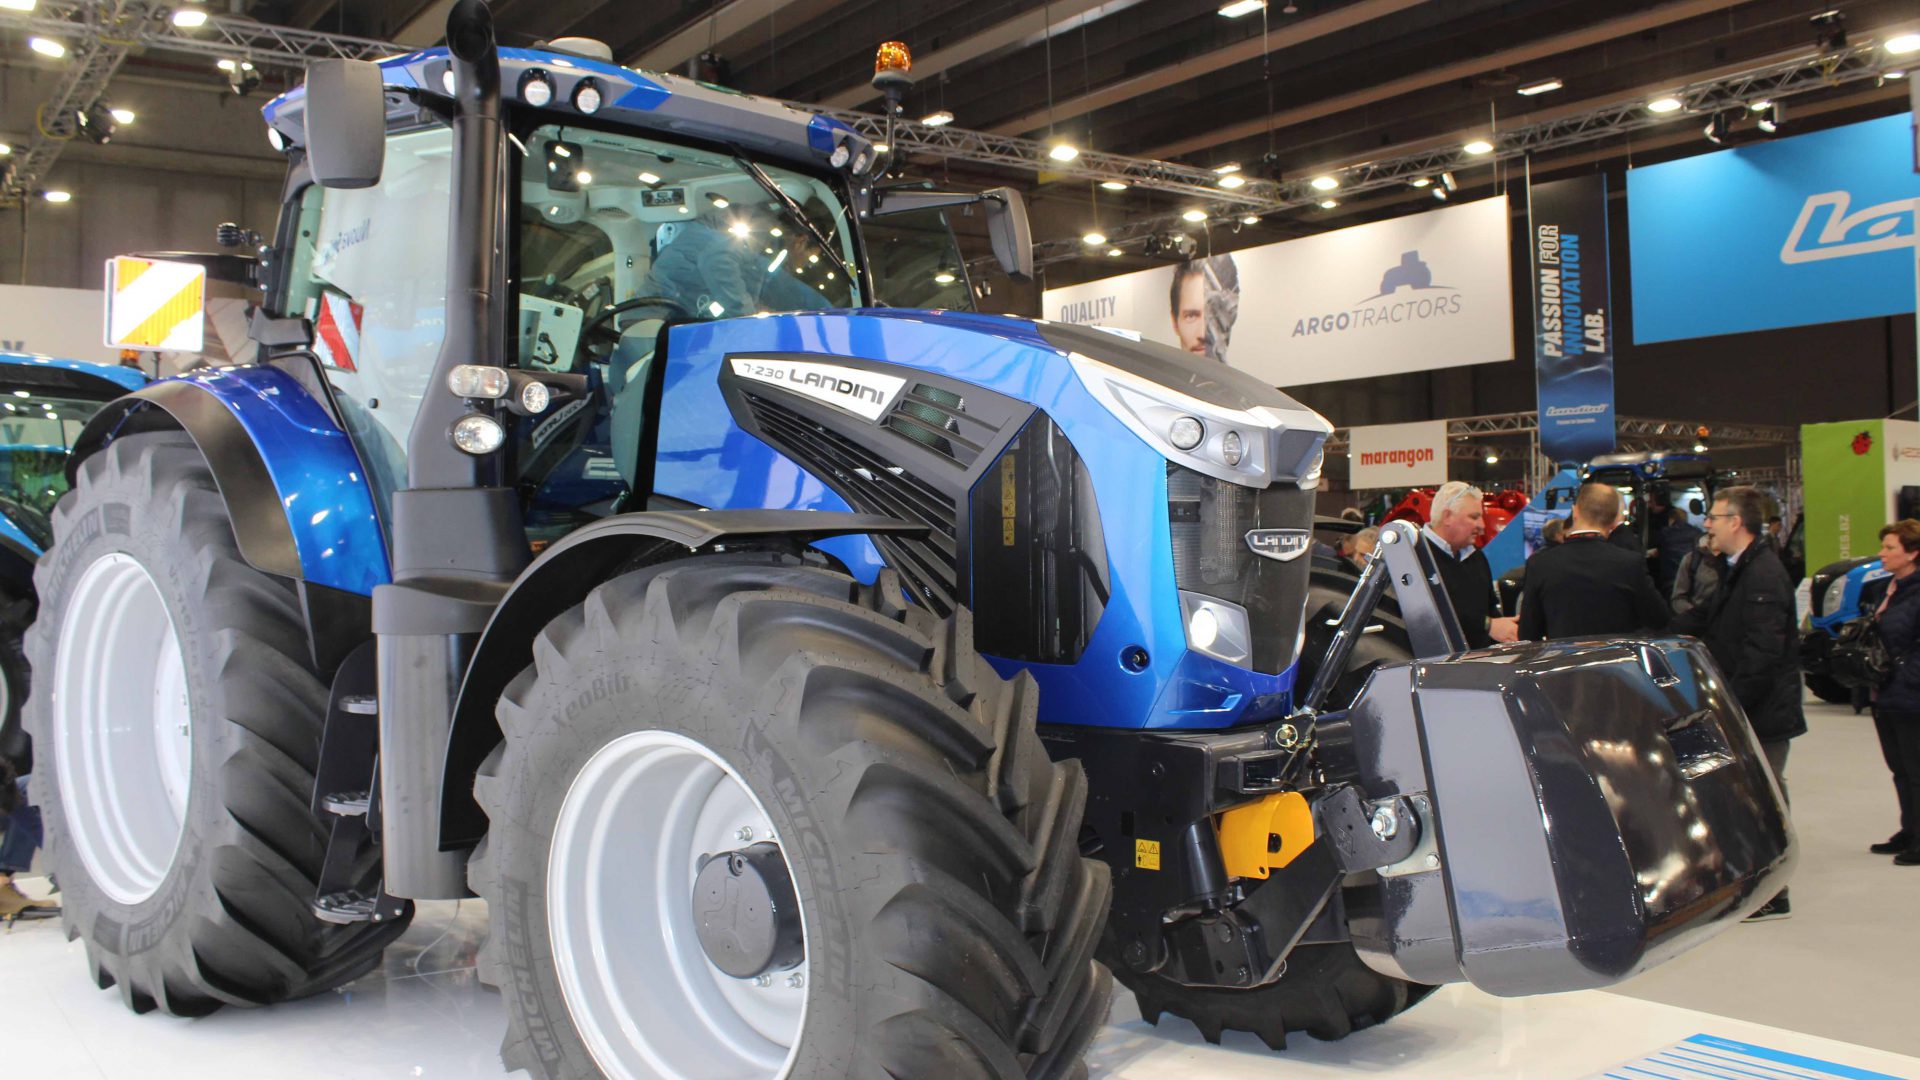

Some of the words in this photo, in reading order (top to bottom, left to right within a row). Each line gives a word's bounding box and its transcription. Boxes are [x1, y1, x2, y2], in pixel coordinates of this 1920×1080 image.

[1538, 224, 1560, 264] FOR
[1061, 296, 1116, 323] QUALITY
[1292, 294, 1462, 337] ARGOTRACTORS
[1540, 269, 1563, 357] PASSION
[1560, 234, 1584, 355] INNOVATION
[1584, 308, 1605, 353] LAB.
[789, 368, 885, 405] LANDINI
[1361, 448, 1433, 468] marangon
[1253, 534, 1307, 546] LANDINI
[776, 776, 848, 998] MICHELIN
[505, 880, 560, 1061] MICHELIN
